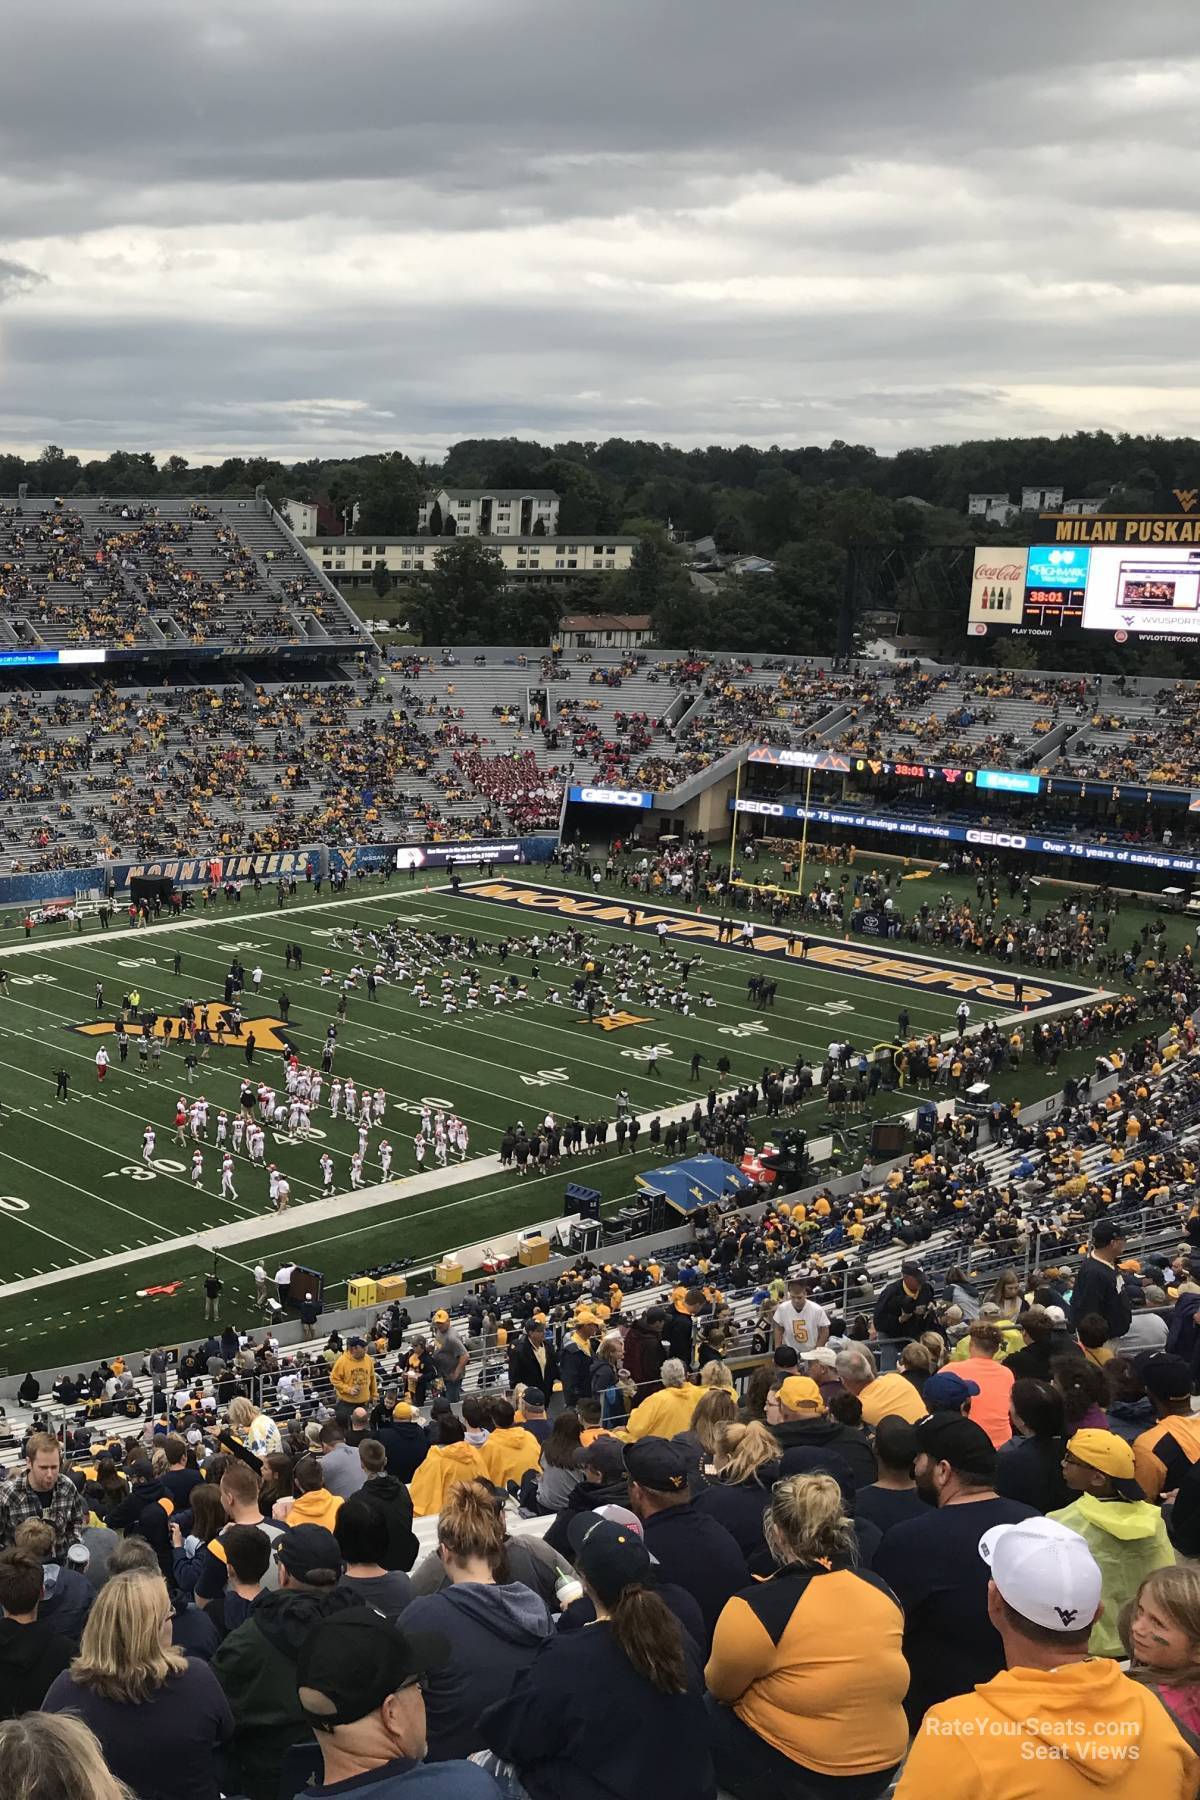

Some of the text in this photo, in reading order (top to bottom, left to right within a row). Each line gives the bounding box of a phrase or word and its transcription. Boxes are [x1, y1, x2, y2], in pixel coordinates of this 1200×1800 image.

[1056, 521, 1117, 541] MILAN
[1030, 591, 1063, 602] 38:01
[1139, 634, 1199, 643] WVLOTTERY.COM
[856, 760, 865, 771] 0
[894, 765, 924, 777] 38:01
[965, 772, 973, 783] 0
[581, 788, 642, 806] GEICO
[735, 800, 783, 815] GEICO
[818, 810, 829, 819] 75
[831, 814, 853, 824] years
[856, 815, 865, 825] of
[866, 819, 898, 830] savings
[900, 821, 916, 832] and
[918, 825, 949, 836] service
[966, 829, 1026, 849] GEICO
[1043, 841, 1066, 852] Over
[1069, 845, 1083, 855] 75
[1086, 847, 1114, 860] years
[1117, 849, 1128, 860] of
[1131, 854, 1170, 867] savings
[1173, 857, 1193, 869] and
[806, 1001, 855, 1017] 10
[718, 1022, 770, 1038] 20
[520, 1068, 570, 1087] 40
[393, 1096, 454, 1115] 50
[120, 1158, 187, 1181] 30
[792, 1319, 809, 1344] 5
